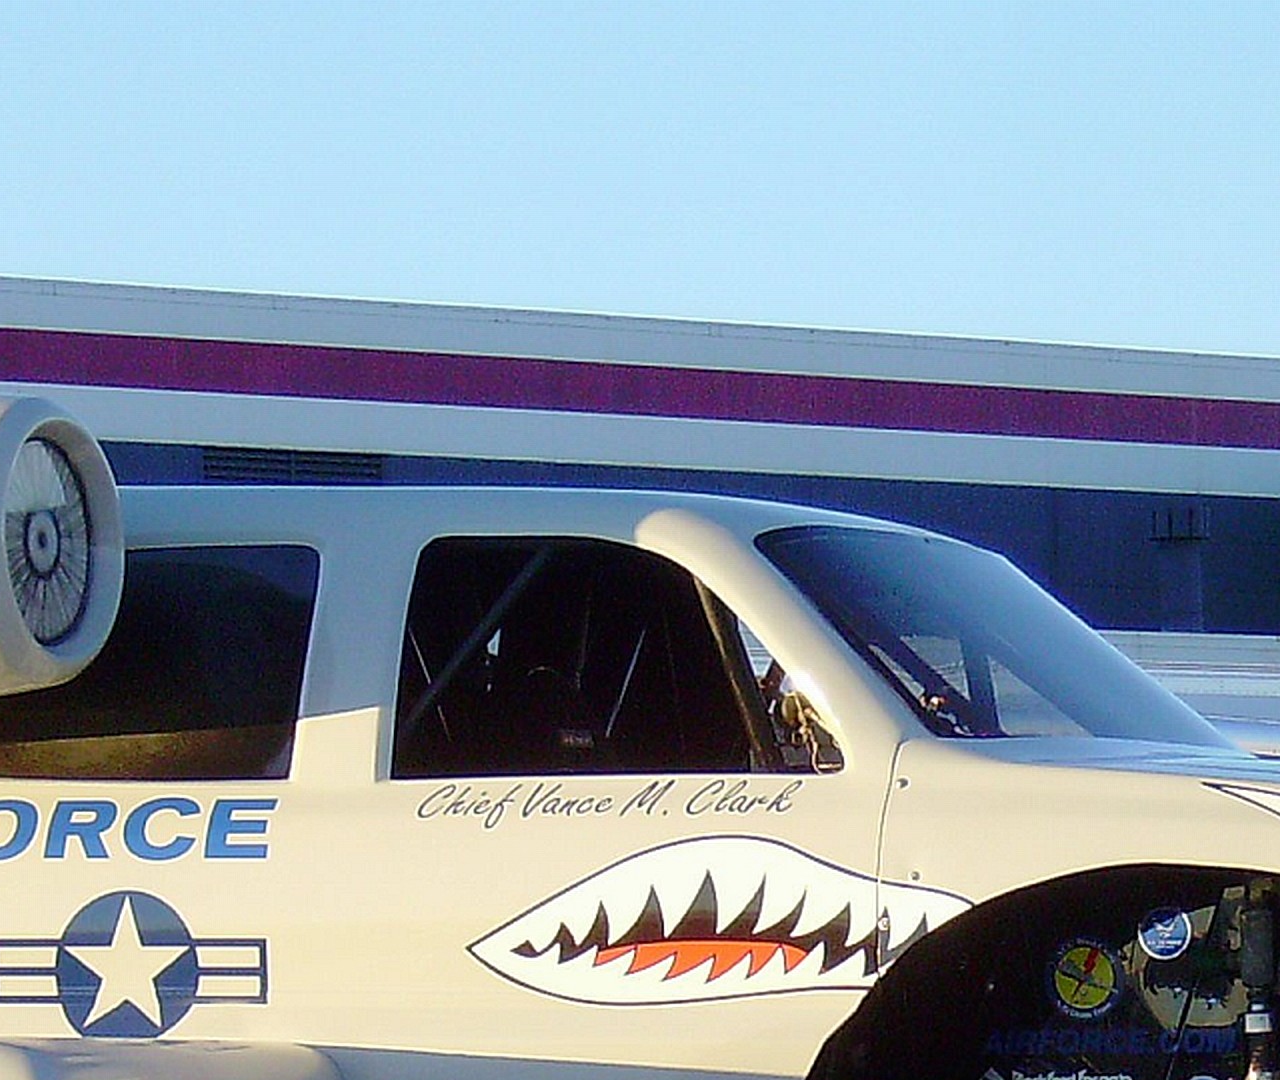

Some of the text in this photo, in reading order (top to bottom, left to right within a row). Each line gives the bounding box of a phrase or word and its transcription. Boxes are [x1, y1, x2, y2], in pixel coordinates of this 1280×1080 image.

[417, 779, 804, 829] Chief Vance M. Clark
